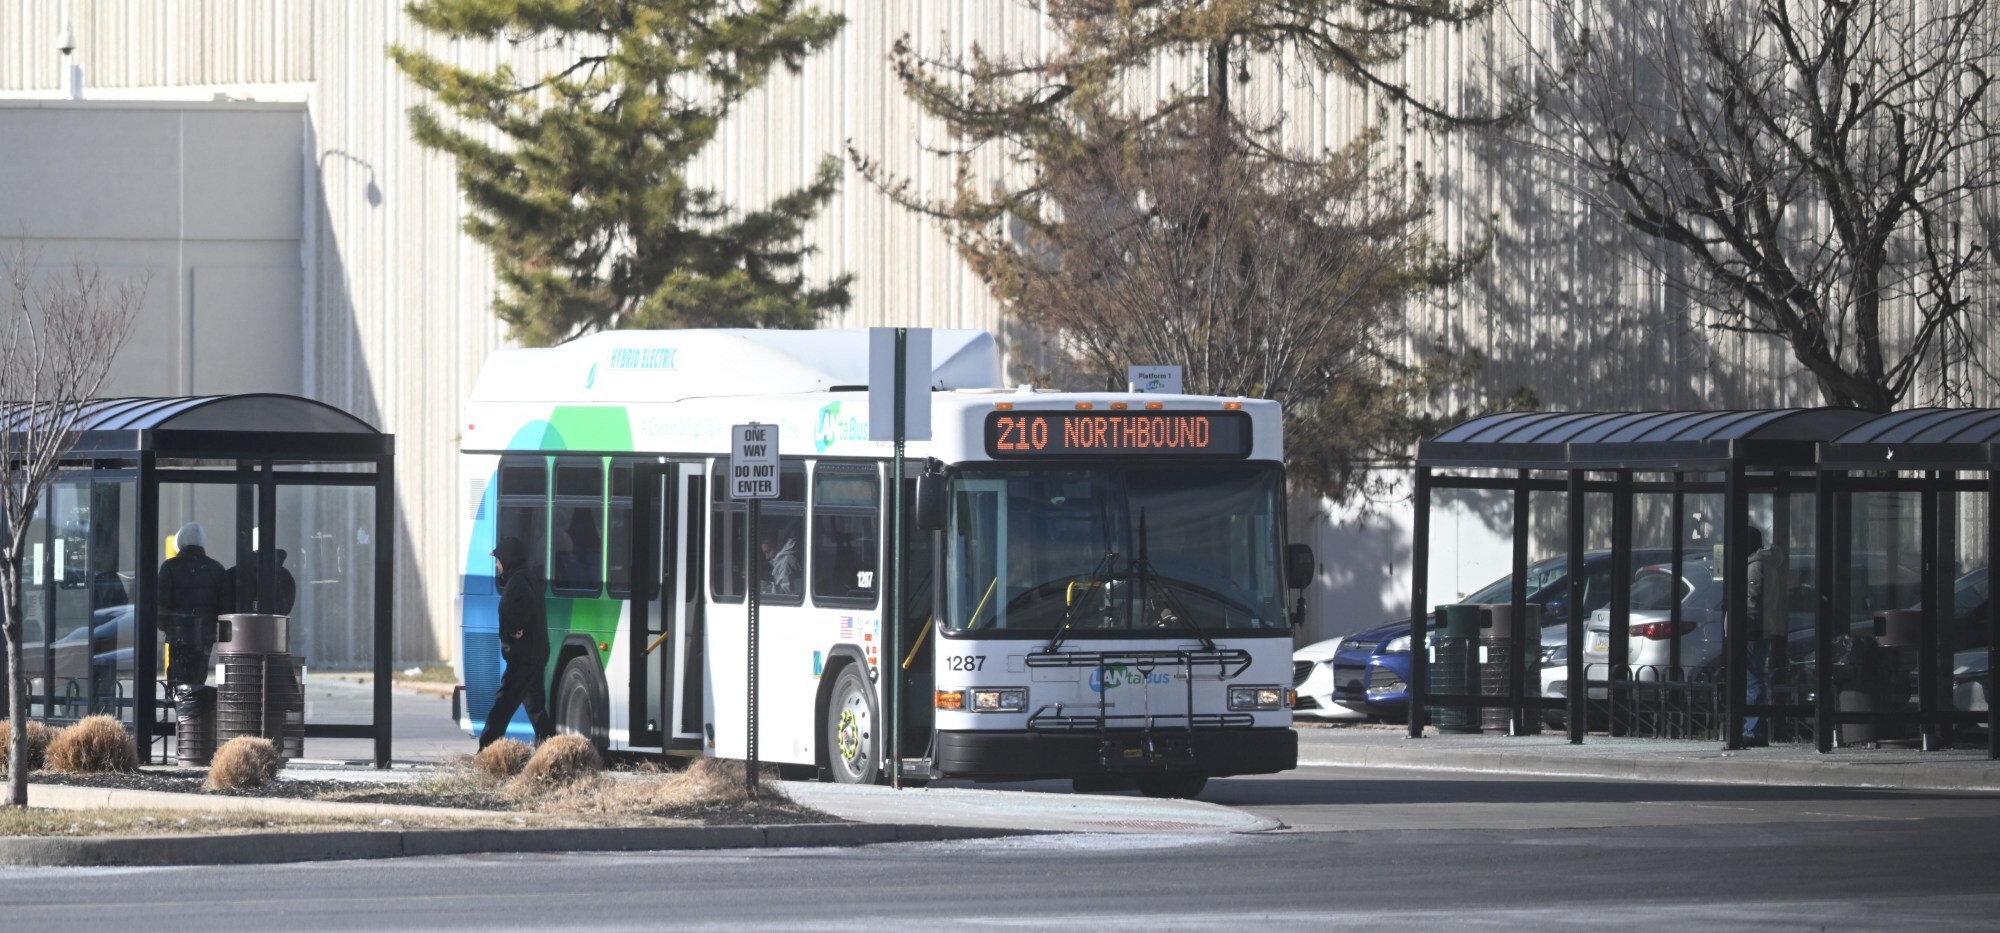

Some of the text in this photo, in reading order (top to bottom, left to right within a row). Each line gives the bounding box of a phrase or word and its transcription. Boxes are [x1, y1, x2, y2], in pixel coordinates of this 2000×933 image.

[610, 347, 677, 369] HYBRID ELECTRIC
[745, 429, 766, 441] ONE
[997, 416, 1209, 450] 210 NORTHBOUND
[744, 445, 767, 457] WAY
[735, 465, 775, 477] DO NOT
[738, 480, 772, 492] ENTER
[857, 571, 873, 588] 1287
[946, 655, 986, 671] 1287
